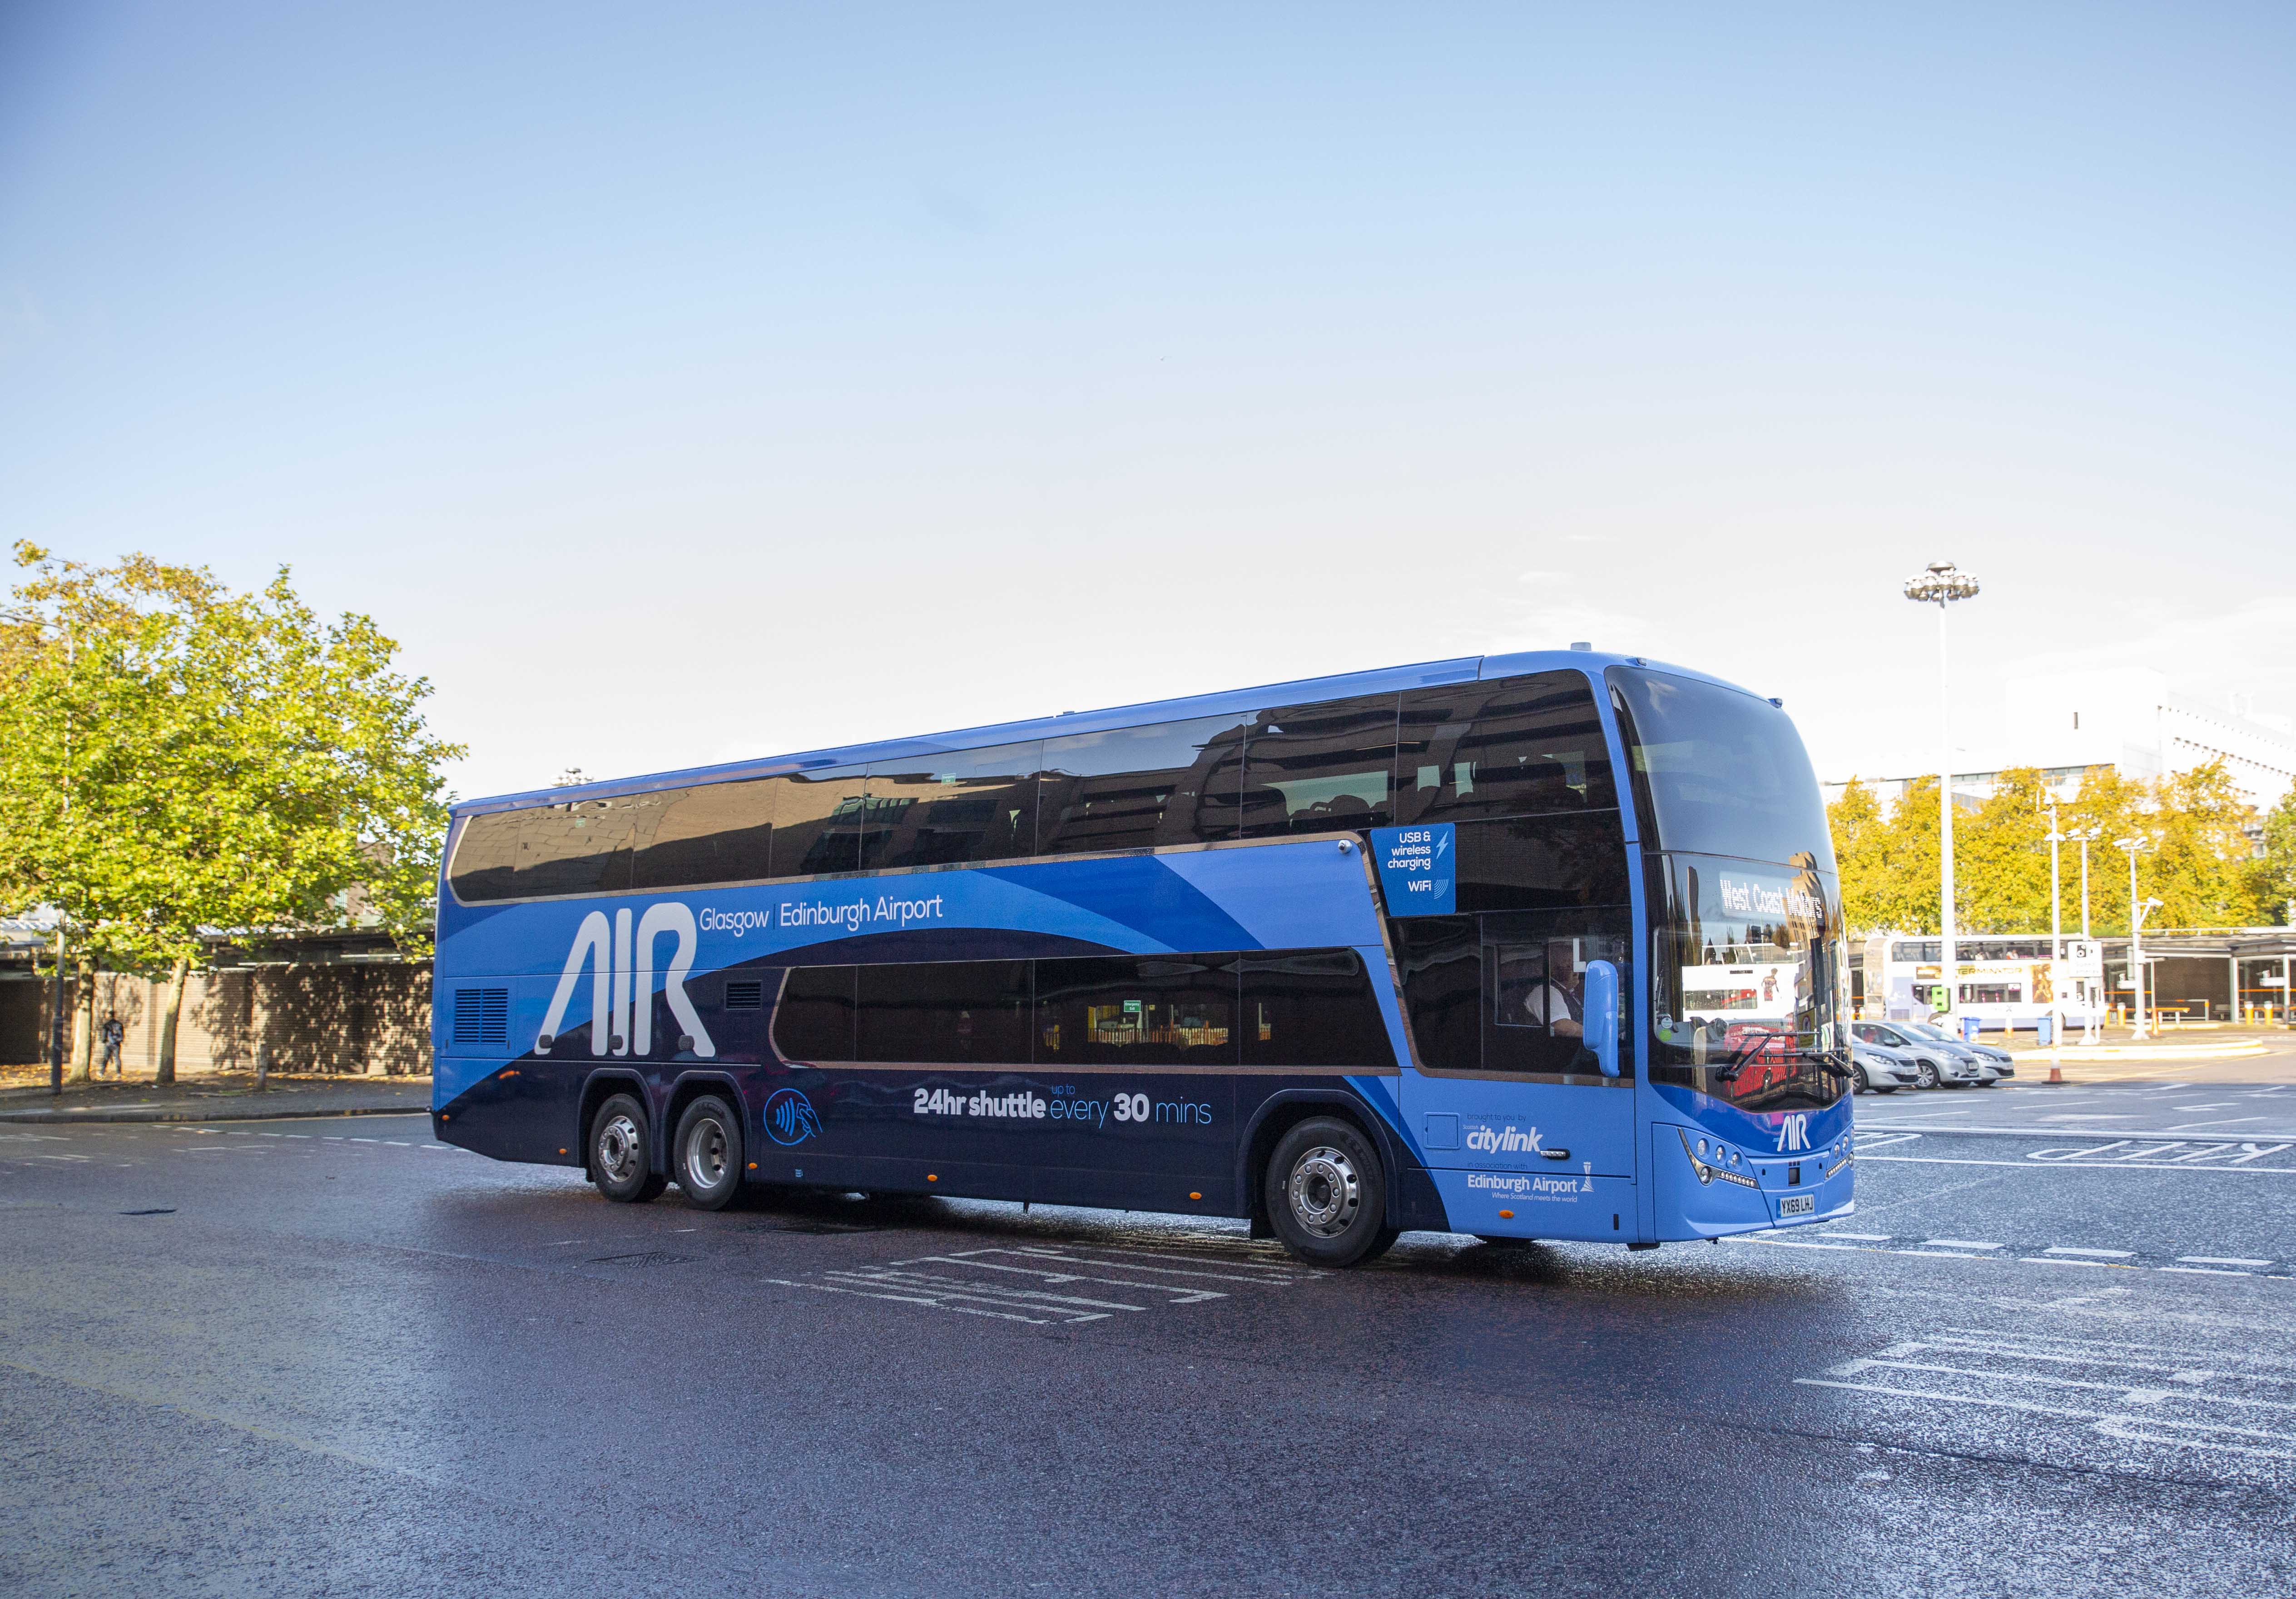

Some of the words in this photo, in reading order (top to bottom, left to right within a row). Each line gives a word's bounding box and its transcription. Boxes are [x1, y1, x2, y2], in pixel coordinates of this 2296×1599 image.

[1399, 832, 1421, 843] USB
[1423, 831, 1431, 842] &
[1391, 844, 1431, 856] wireless
[1388, 857, 1431, 871] charging
[1408, 880, 1431, 892] WiFi
[1720, 879, 1752, 911] West
[1753, 884, 1785, 915] Coast
[699, 908, 770, 937] Glasgow
[780, 898, 870, 931] Edinburgh
[873, 894, 943, 927] Airport
[535, 902, 715, 1057] AIR
[1051, 1085, 1064, 1097] up
[1066, 1084, 1076, 1094] to
[914, 1088, 967, 1115] 24hr
[969, 1090, 1046, 1118] shuttle
[1050, 1100, 1108, 1128] every
[1114, 1093, 1150, 1122] 30
[1156, 1096, 1211, 1124] mins
[1467, 1113, 1493, 1122] brought
[1467, 1125, 1543, 1154] citylink
[1777, 1114, 1810, 1152] AIR
[1468, 1174, 1530, 1192] Edinburgh
[1532, 1177, 1577, 1194] Airport
[1510, 1192, 1533, 1201] Scotland
[1781, 1198, 1800, 1214] YX69
[1800, 1197, 1813, 1211] LHJ
